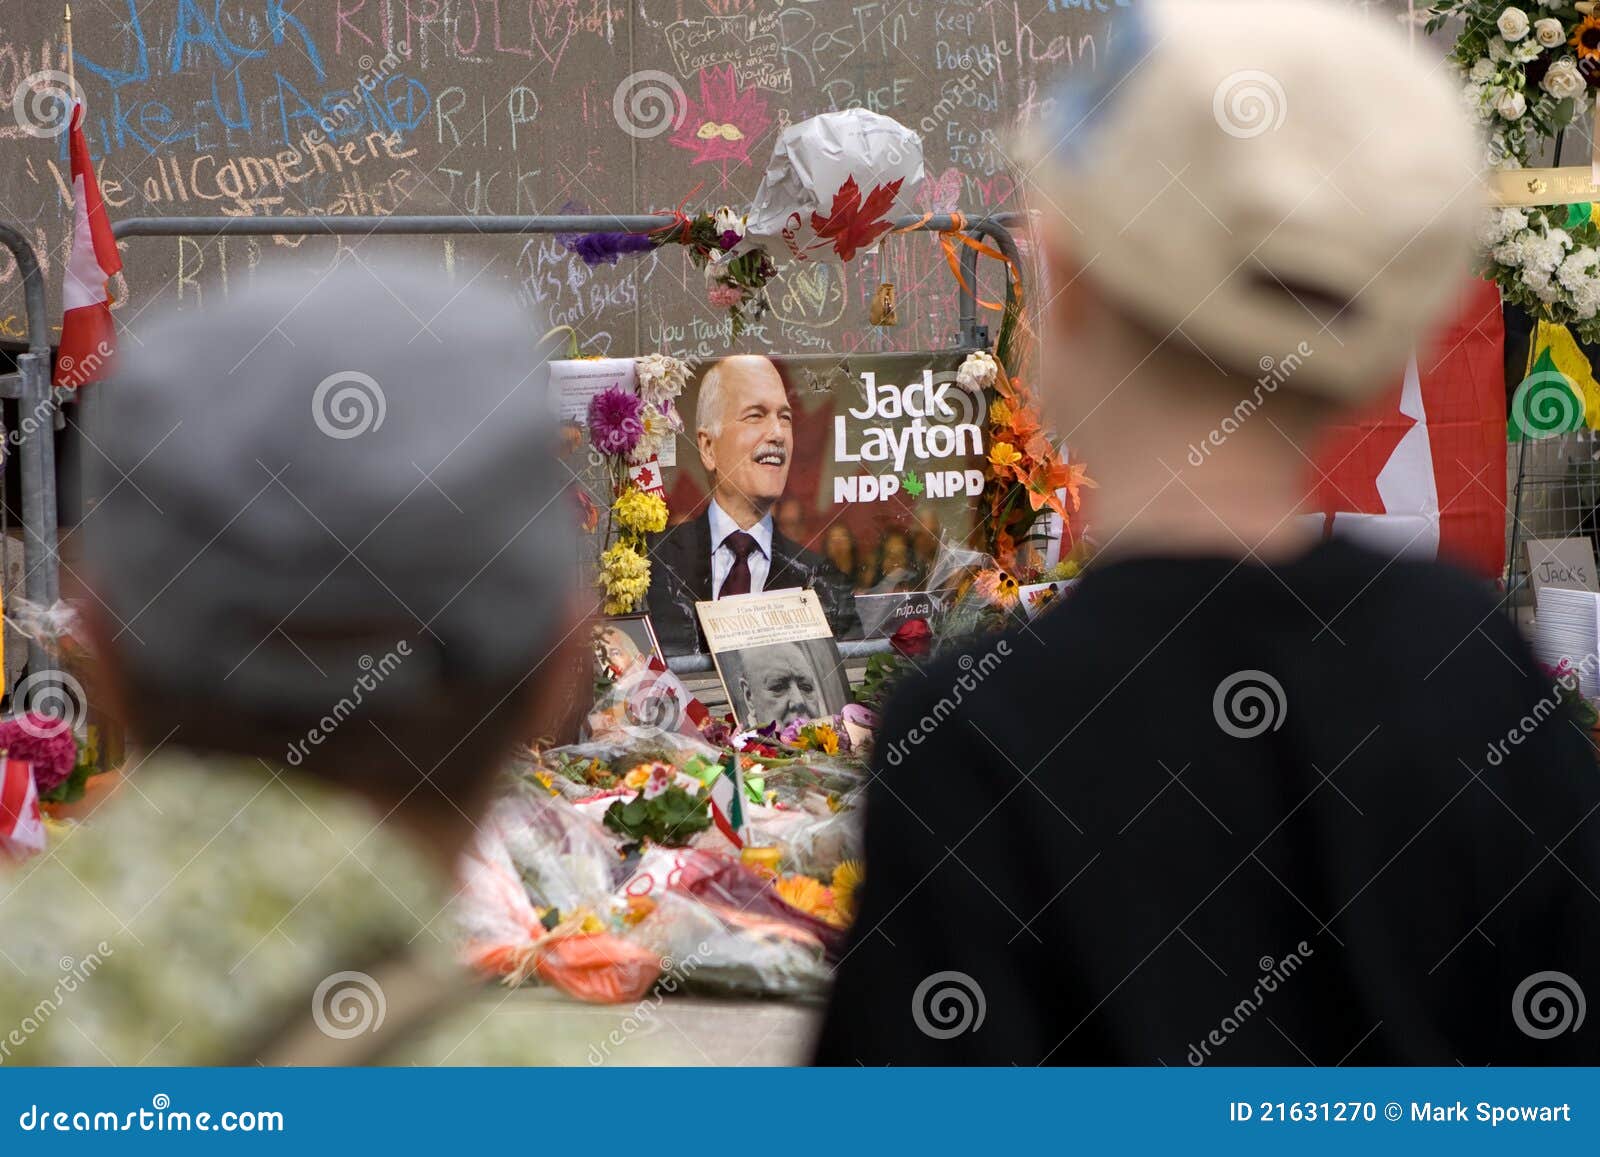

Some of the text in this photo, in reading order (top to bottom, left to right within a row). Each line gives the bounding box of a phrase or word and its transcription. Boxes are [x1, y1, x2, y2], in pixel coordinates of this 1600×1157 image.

[58, 0, 327, 88] JACK
[849, 370, 954, 420] Jack
[835, 416, 983, 471] Layton
[834, 470, 985, 503] NDP NPD
[896, 602, 929, 618] ndp.ca
